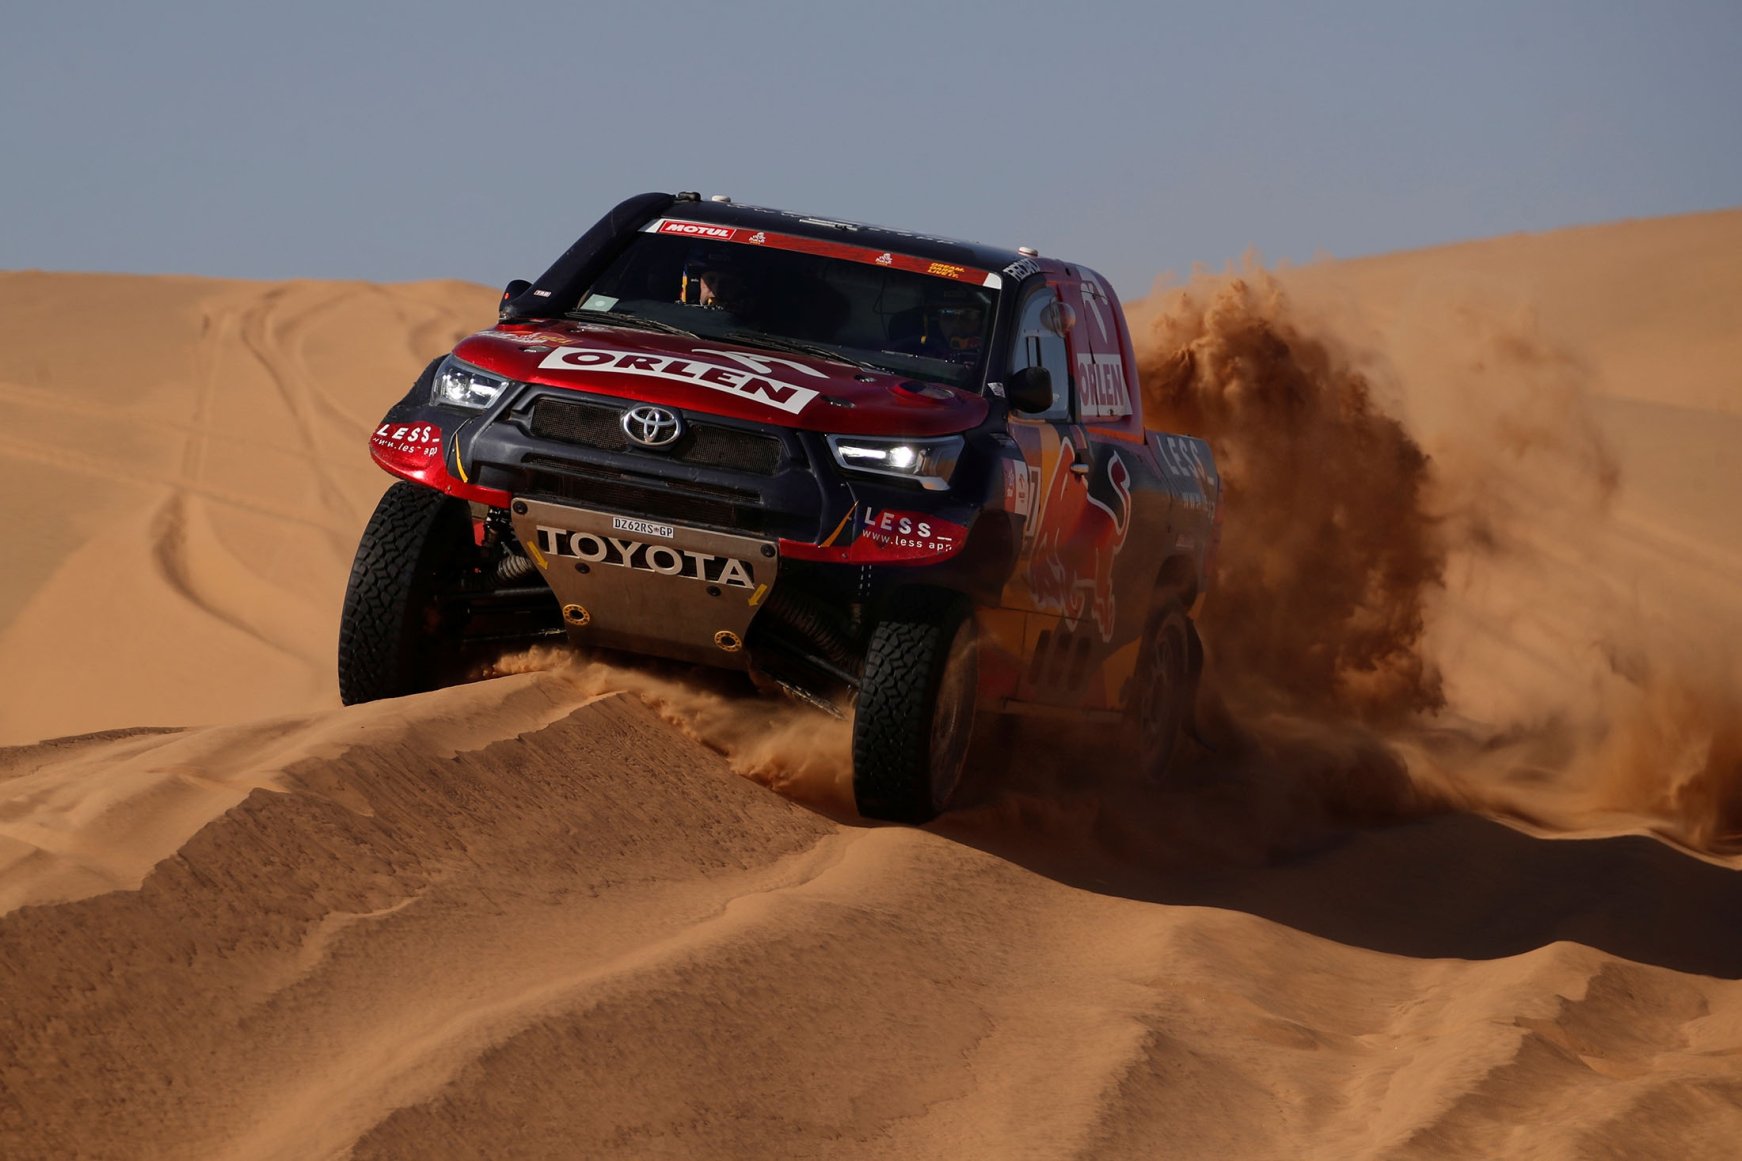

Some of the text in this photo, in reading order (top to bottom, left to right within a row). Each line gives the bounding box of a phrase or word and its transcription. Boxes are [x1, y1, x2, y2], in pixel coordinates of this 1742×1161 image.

[664, 223, 729, 237] MOTUL
[561, 351, 799, 405] ORLEN
[1078, 362, 1125, 407] ORLEN
[536, 524, 755, 590] TOYOTA
